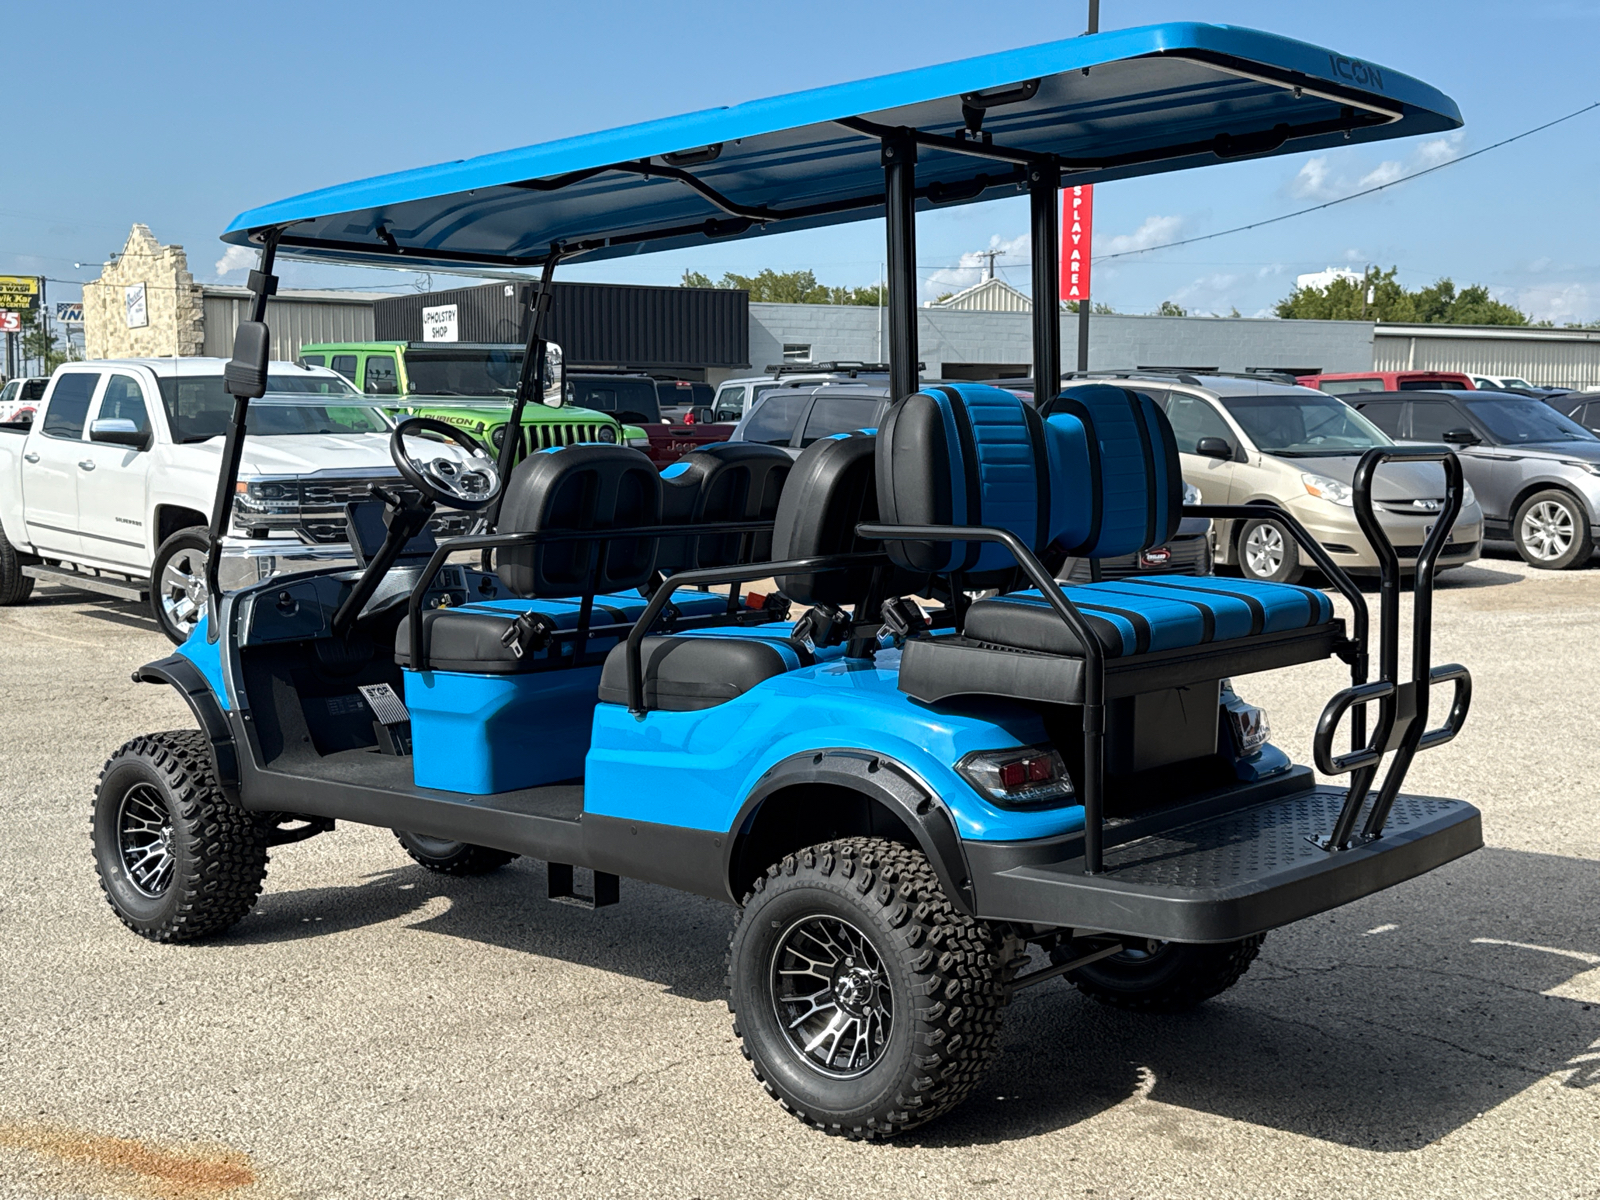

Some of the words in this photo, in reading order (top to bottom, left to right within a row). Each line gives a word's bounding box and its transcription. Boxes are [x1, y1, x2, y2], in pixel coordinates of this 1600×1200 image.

[1328, 54, 1384, 90] ICON
[1071, 185, 1082, 245] SPLAY
[1069, 249, 1081, 296] AREA
[0, 294, 12, 303] wik
[14, 294, 32, 303] Kar
[60, 310, 84, 321] IN
[423, 309, 456, 325] UPHOLSTRY
[432, 325, 448, 339] SHOP
[424, 414, 474, 426] RUBICON
